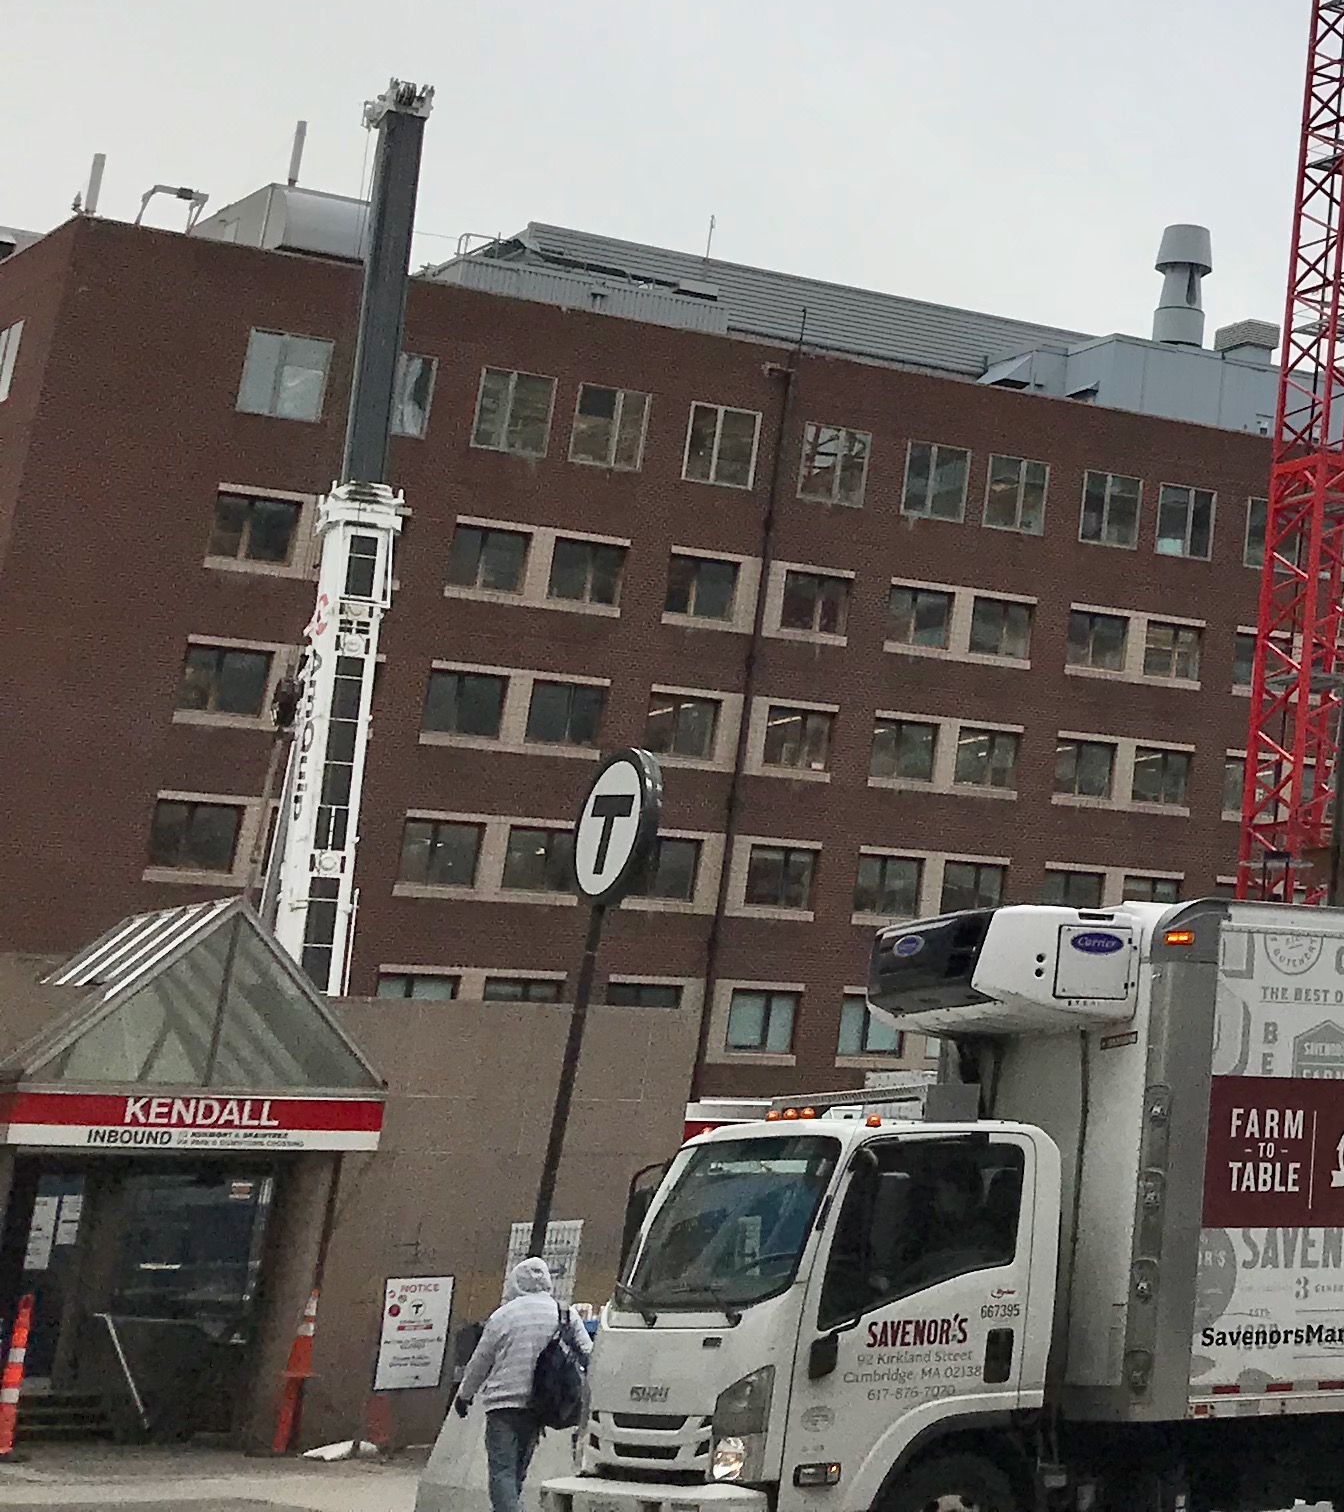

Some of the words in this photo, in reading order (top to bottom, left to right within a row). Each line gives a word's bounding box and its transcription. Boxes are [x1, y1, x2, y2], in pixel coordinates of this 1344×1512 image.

[592, 794, 633, 876] T
[1261, 986, 1288, 1000] THE
[1294, 988, 1329, 1003] BEST
[123, 1096, 280, 1127] KENDALL
[1229, 1107, 1305, 1140] FARM
[87, 1128, 173, 1146] INBOUND
[1228, 1161, 1301, 1193] TABLE
[980, 1304, 1020, 1319] 667395
[866, 1313, 969, 1348] SAVENOR'S
[876, 1351, 932, 1365] Kirkland
[920, 1367, 941, 1379] MA
[943, 1365, 982, 1379] 02138
